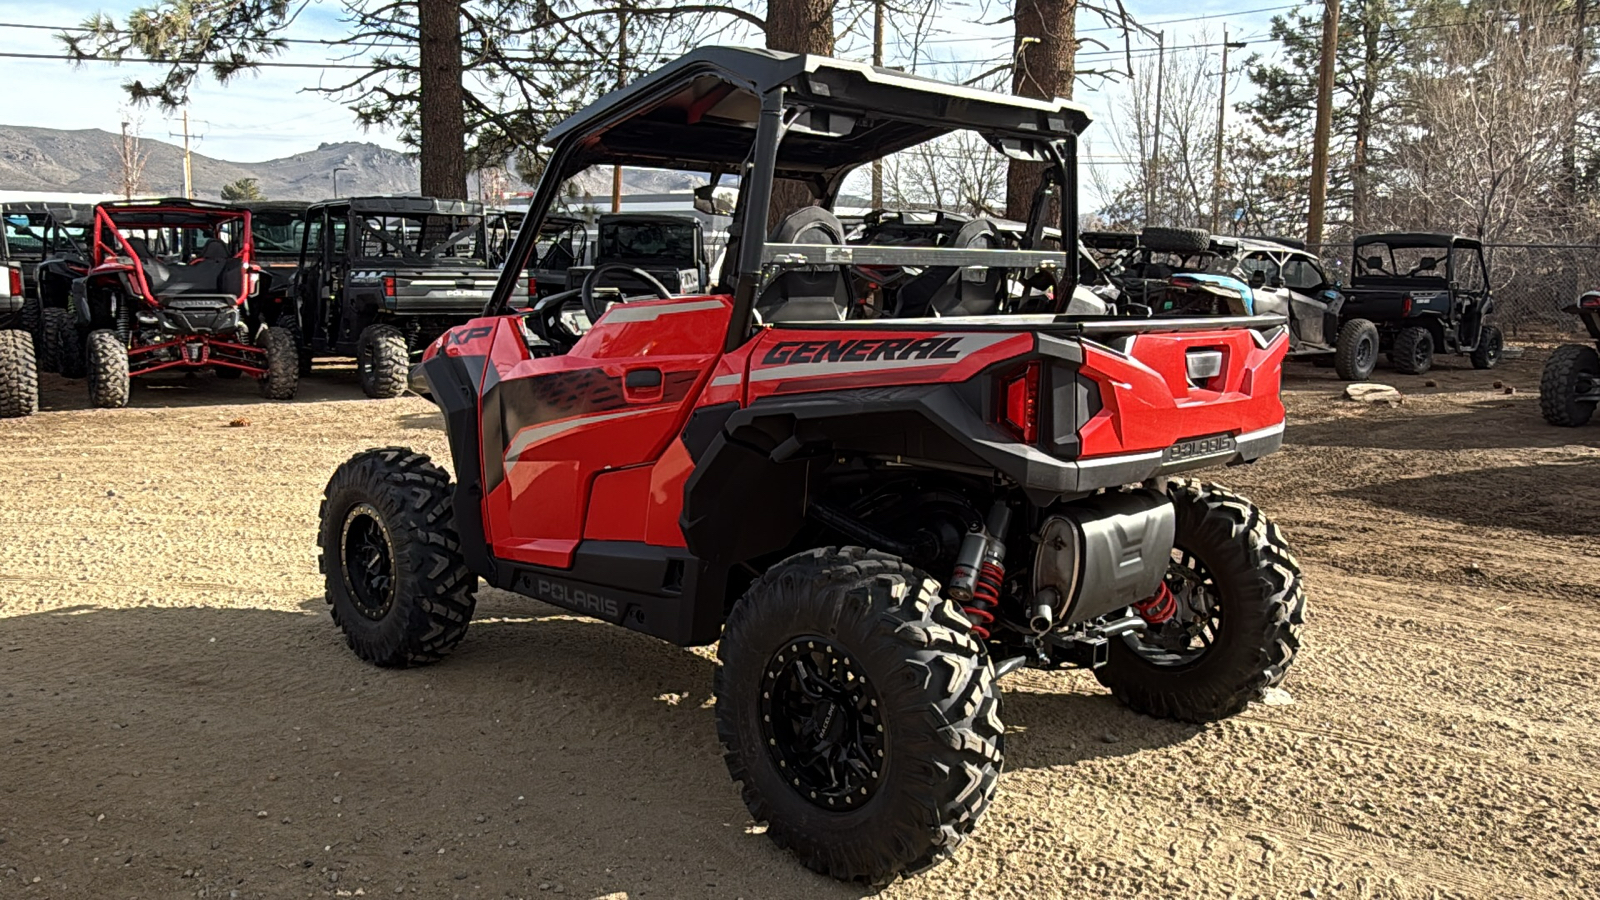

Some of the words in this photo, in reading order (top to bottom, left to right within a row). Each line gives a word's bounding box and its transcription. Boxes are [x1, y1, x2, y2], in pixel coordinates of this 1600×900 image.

[445, 326, 493, 347] XP
[761, 337, 964, 364] GENERAL
[1170, 434, 1231, 459] POLARIS
[538, 579, 619, 617] POLARIS
